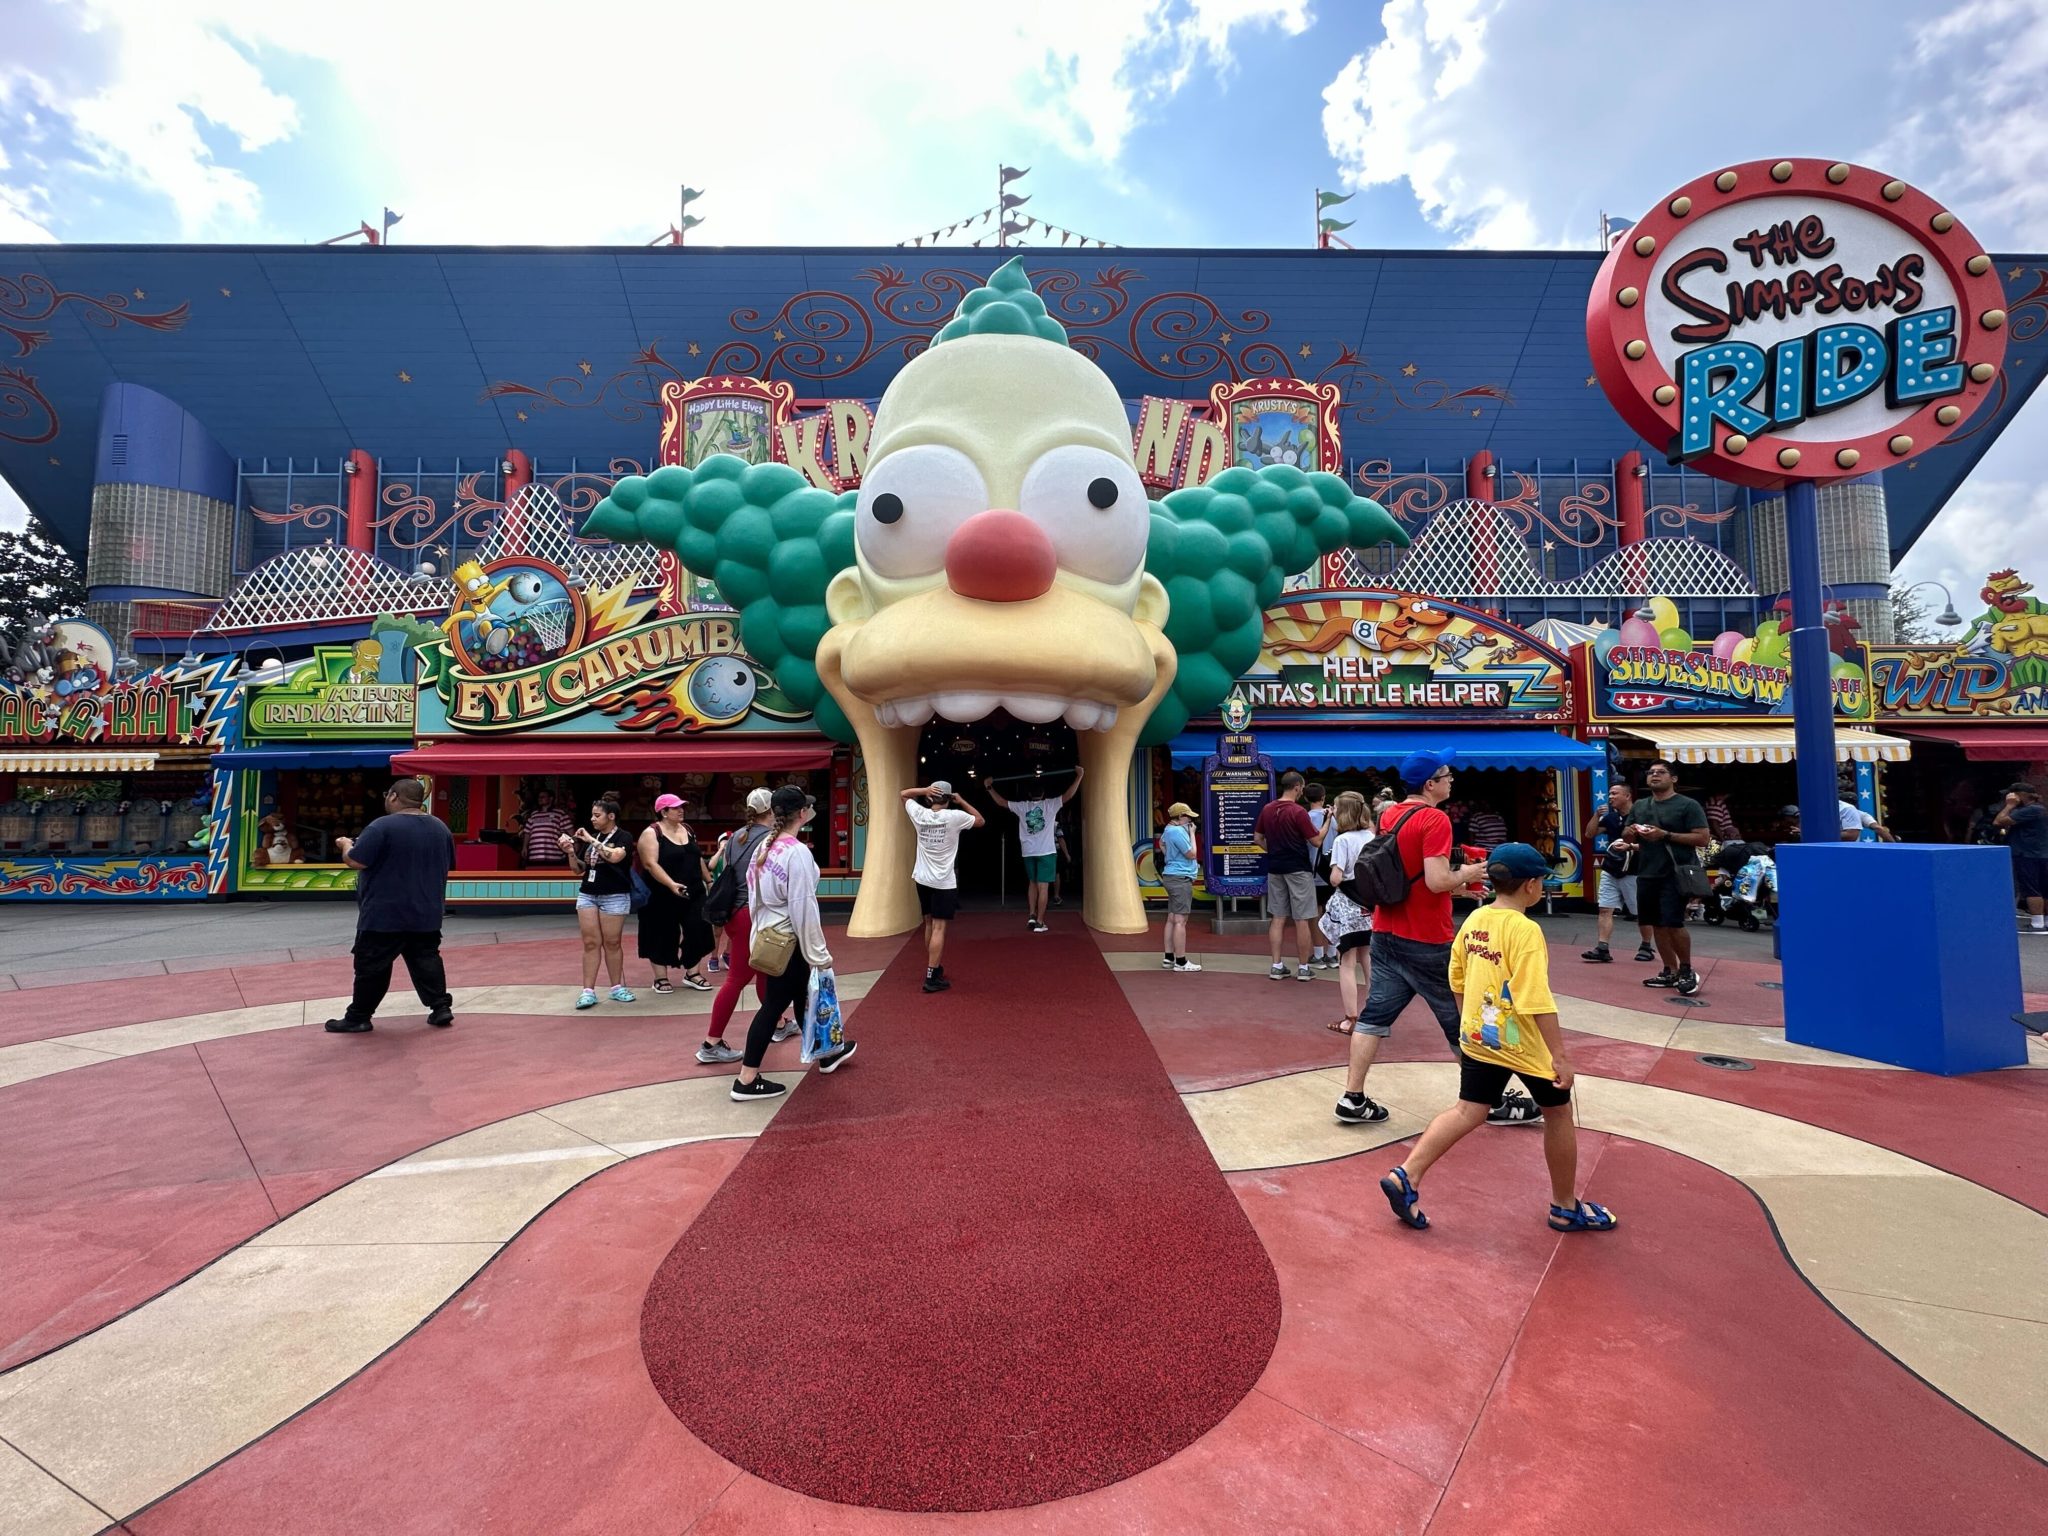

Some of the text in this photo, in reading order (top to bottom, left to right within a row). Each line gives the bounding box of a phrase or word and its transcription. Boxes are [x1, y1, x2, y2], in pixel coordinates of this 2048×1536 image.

[1661, 248, 1924, 343] SIMPSONS
[1668, 306, 1967, 465] RIDE
[741, 400, 764, 414] Elves
[1251, 400, 1298, 414] KRUSTY'S
[1358, 622, 1371, 638] 8
[456, 619, 757, 722] EYE CARUMB
[1323, 657, 1389, 679] HELP
[1607, 645, 1788, 706] SIDESHOW
[327, 687, 361, 702] MR
[1233, 683, 1500, 704] ANTA'S LITTLE HELPER
[62, 697, 100, 740] A
[112, 677, 204, 736] RAT
[265, 703, 412, 723] RADIOACTIVE
[1225, 736, 1253, 744] WAIT TIME
[1228, 756, 1252, 764] MINUTES
